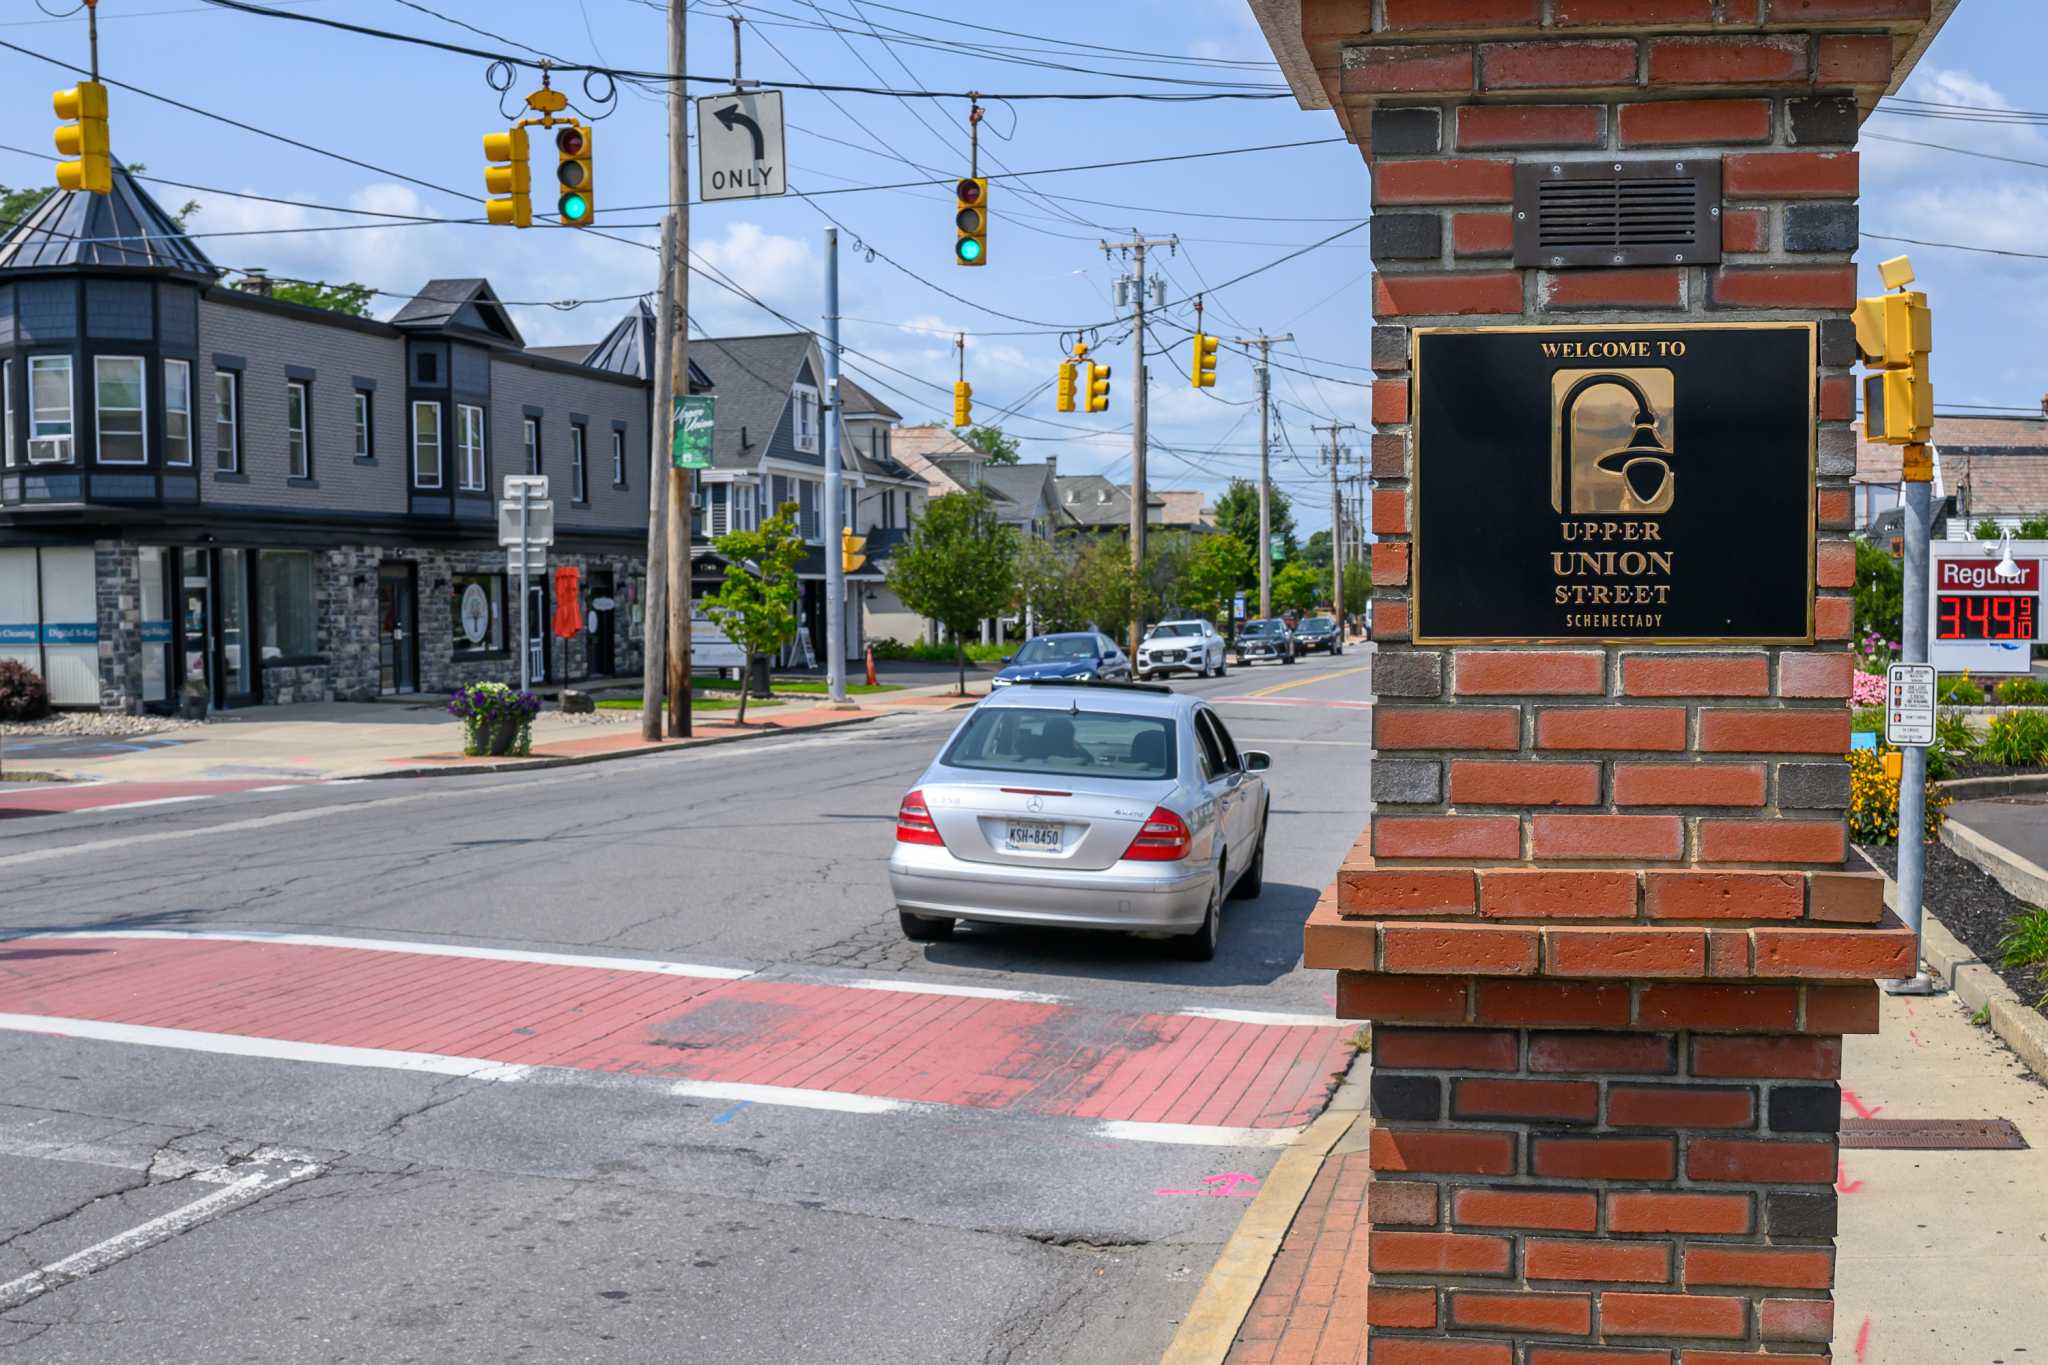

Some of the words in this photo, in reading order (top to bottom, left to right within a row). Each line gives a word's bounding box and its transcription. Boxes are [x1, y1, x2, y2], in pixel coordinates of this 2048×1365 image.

[712, 166, 773, 190] ONLY
[1541, 342, 1651, 358] WELCOME
[1657, 341, 1686, 357] TO
[1550, 551, 1674, 576] UNION
[1566, 614, 1662, 627] SCHENECTADY
[1940, 597, 2015, 639] 3.49
